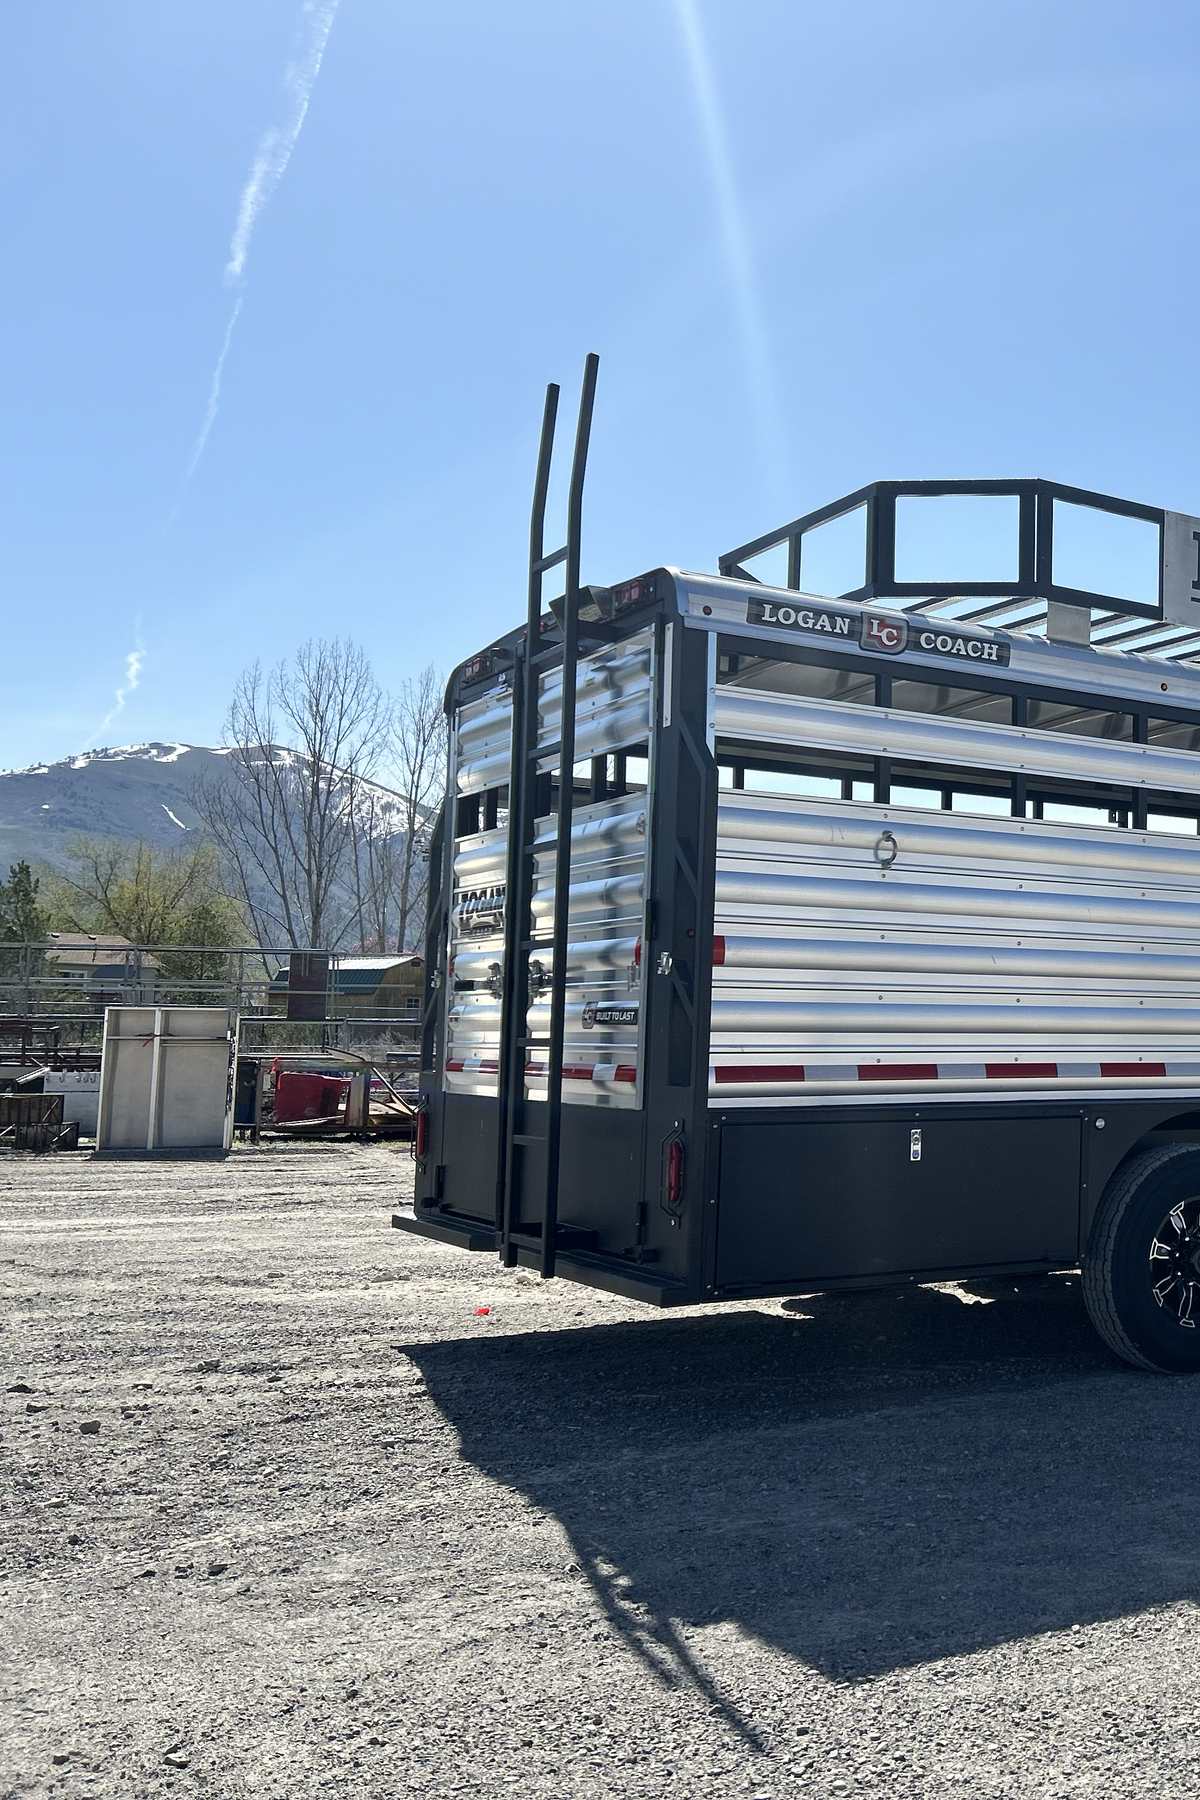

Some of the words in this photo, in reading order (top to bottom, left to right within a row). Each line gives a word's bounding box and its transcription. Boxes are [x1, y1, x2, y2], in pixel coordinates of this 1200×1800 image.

[761, 603, 850, 635] LOGAN
[870, 618, 898, 646] LC
[919, 632, 999, 661] COACH
[619, 1011, 635, 1021] LAST
